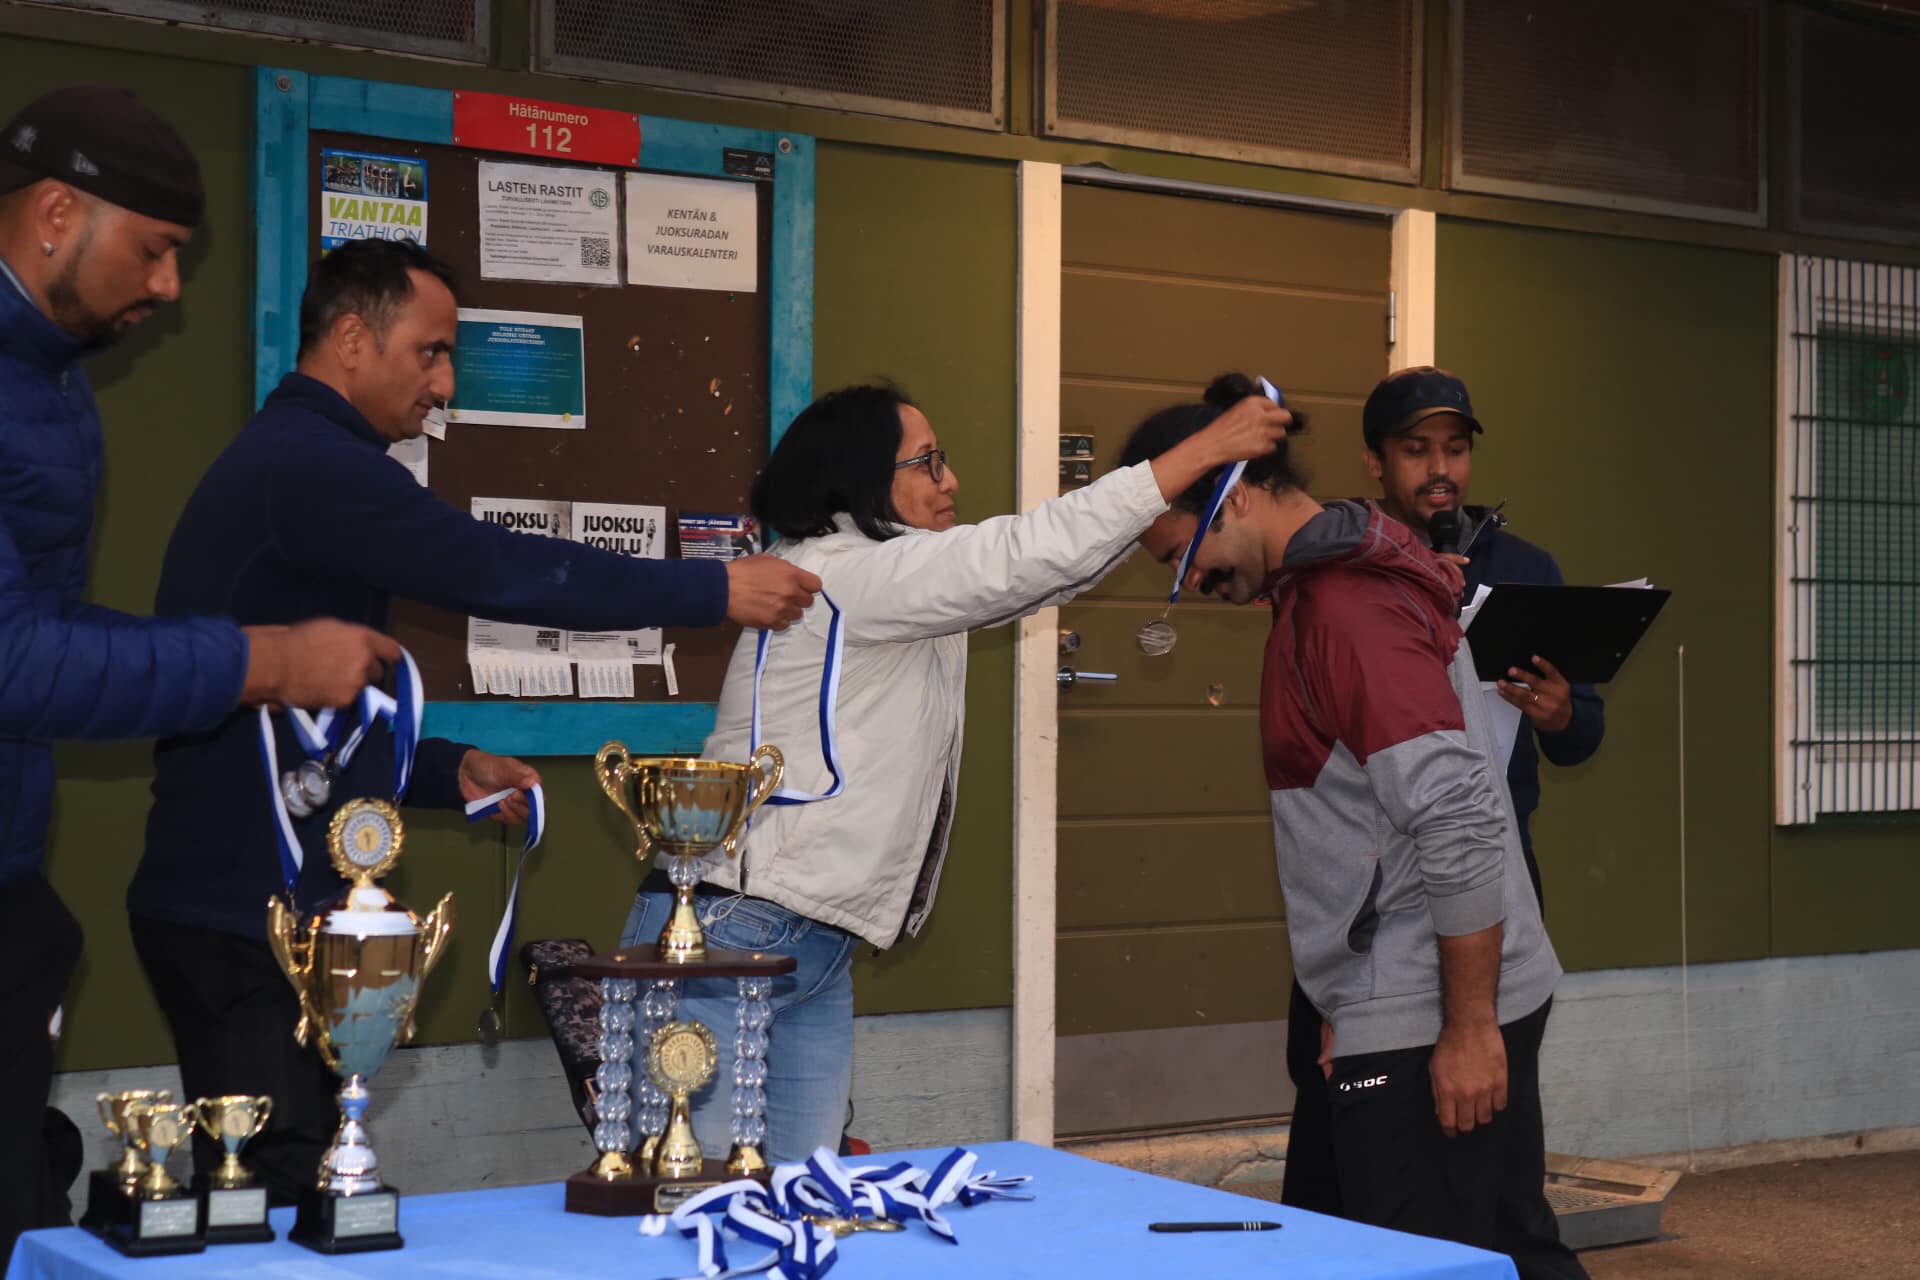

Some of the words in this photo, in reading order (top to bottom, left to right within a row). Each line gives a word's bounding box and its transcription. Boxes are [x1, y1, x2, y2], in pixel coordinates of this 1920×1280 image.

[509, 102, 589, 126] Hätänumero
[526, 123, 572, 153] 112
[487, 180, 537, 195] LASTEN
[540, 184, 584, 198] RASTIT
[329, 197, 422, 227] VANTAA
[667, 208, 707, 221] KENTÄN
[709, 212, 717, 222] &
[329, 221, 422, 244] TRIATHLON
[656, 226, 729, 240] JUOKSURADAN
[647, 244, 738, 260] VARAUSKALENTERI
[583, 515, 645, 534] JUOKSU
